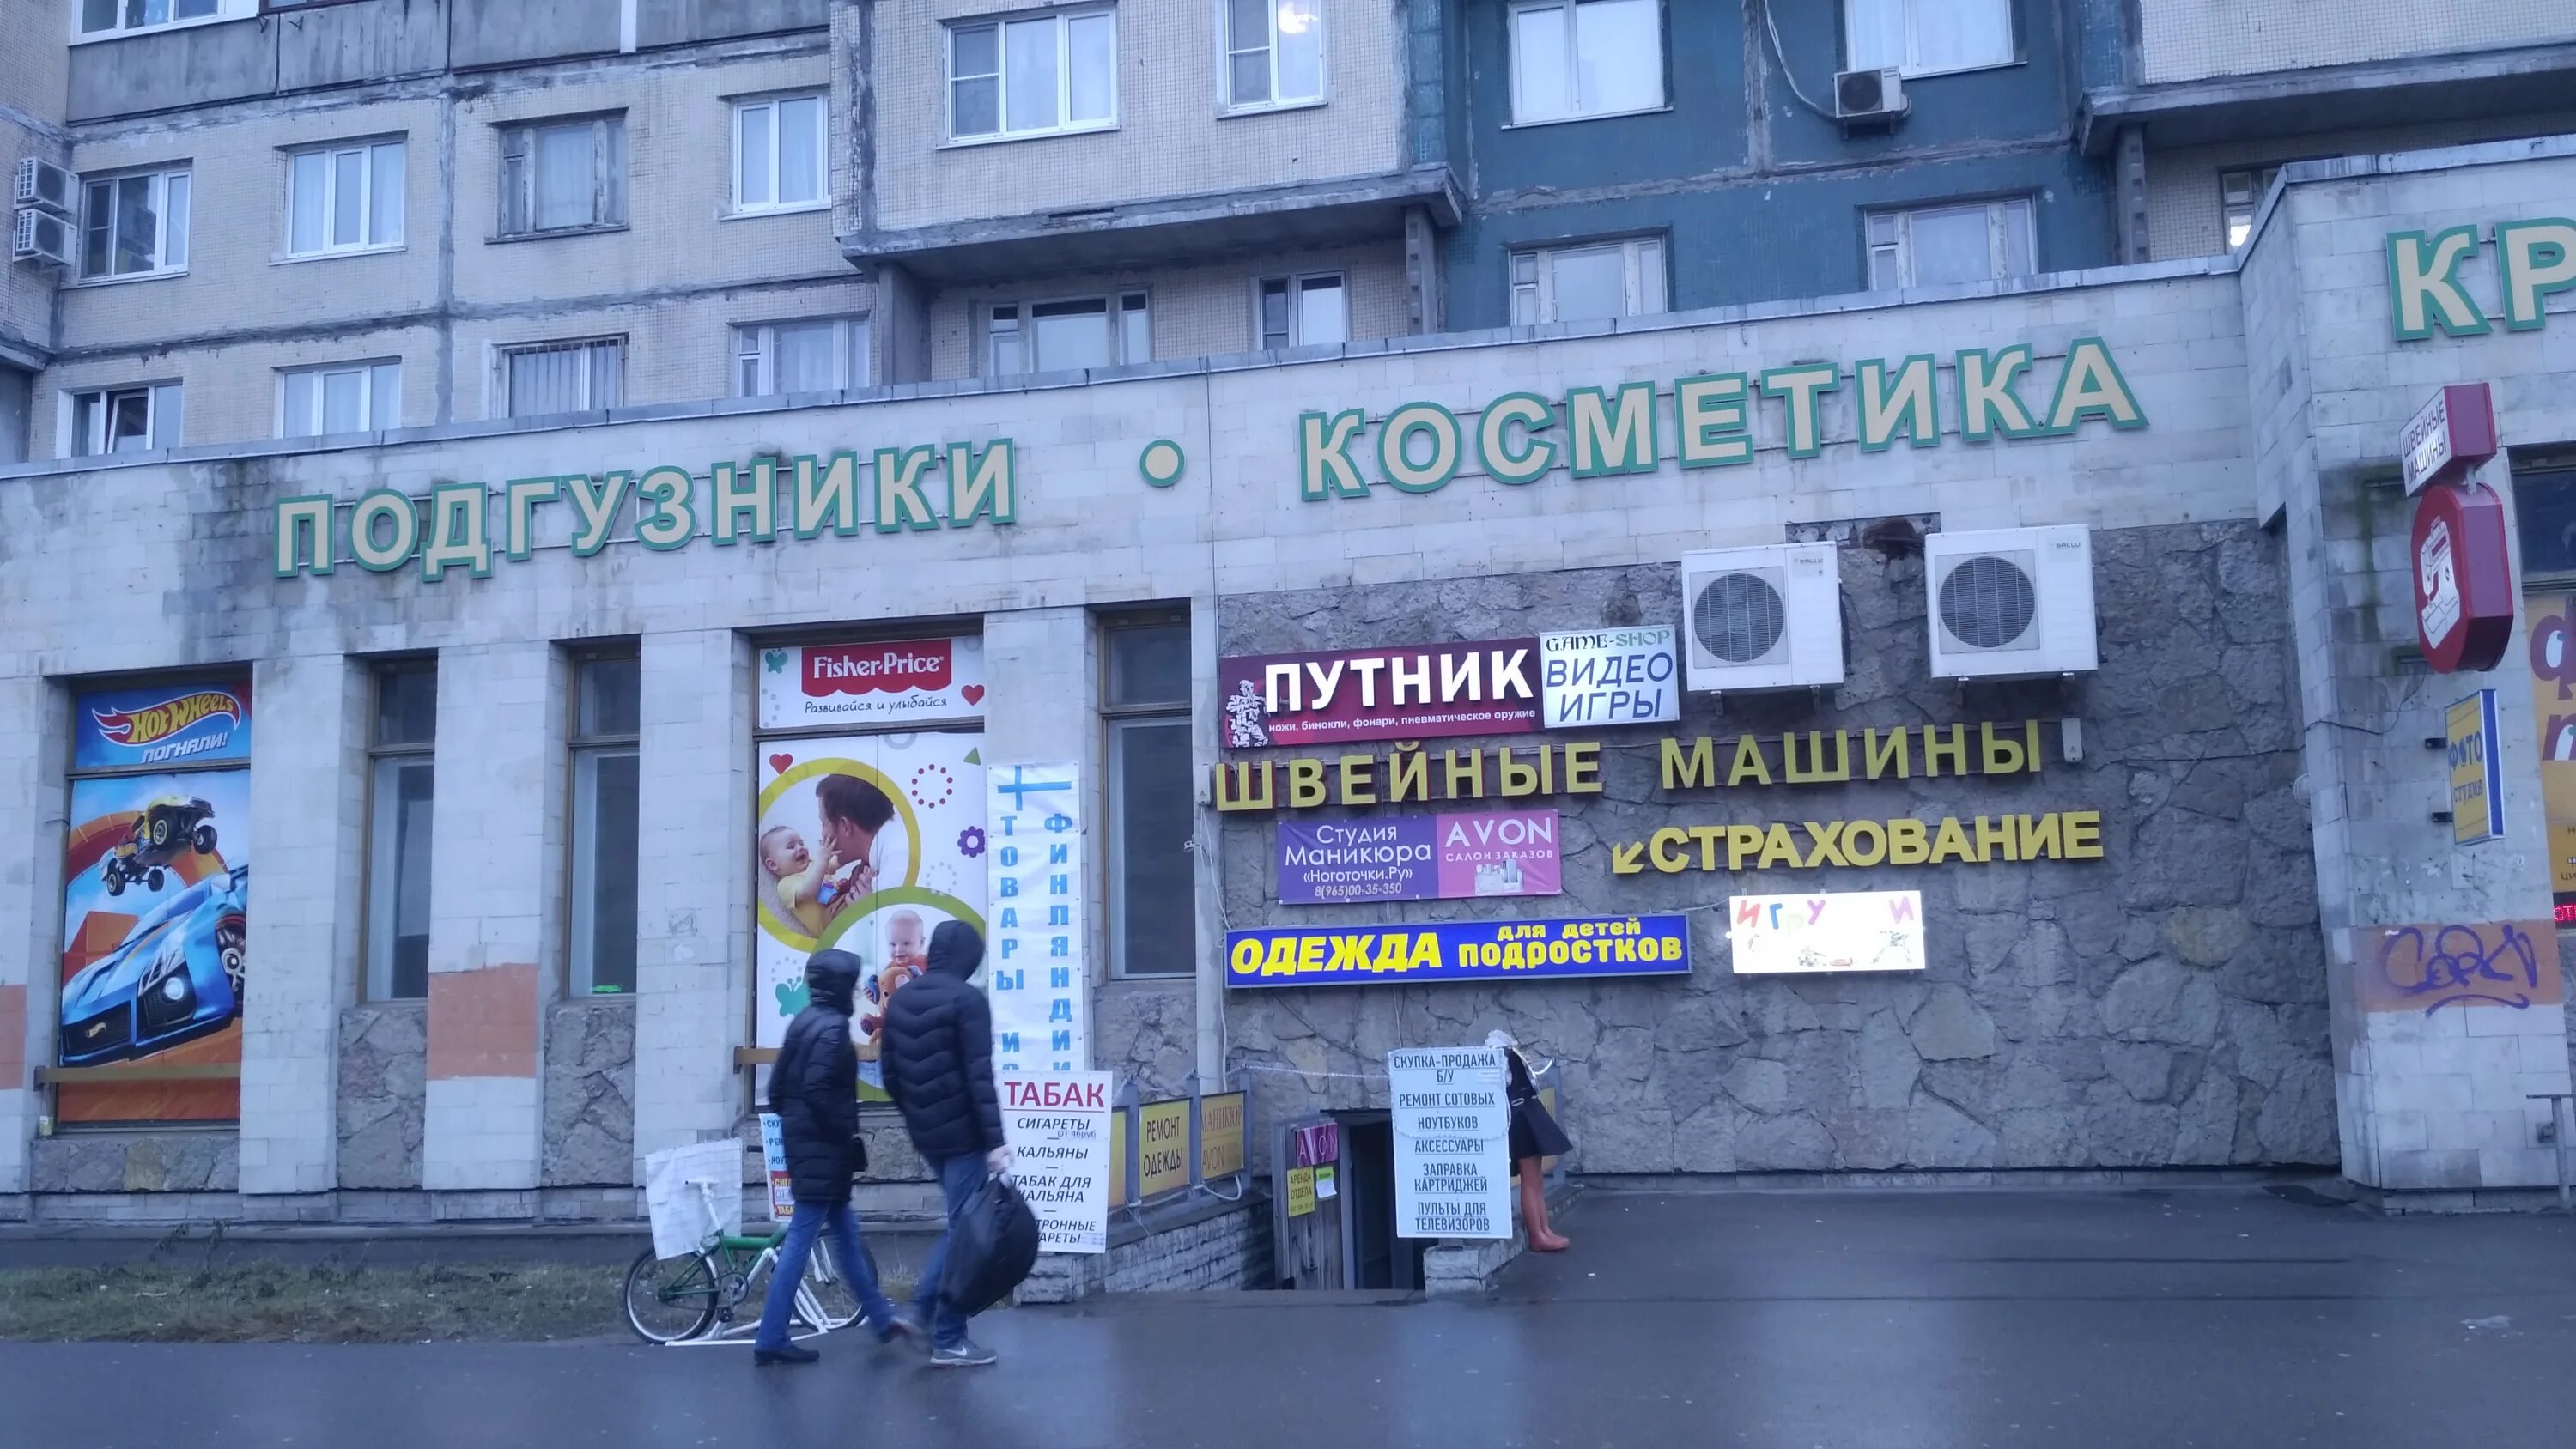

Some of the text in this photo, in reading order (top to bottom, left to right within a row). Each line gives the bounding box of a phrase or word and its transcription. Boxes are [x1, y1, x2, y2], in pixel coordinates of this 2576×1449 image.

[1298, 336, 2151, 502] КОСМЕТИКА
[2403, 400, 2445, 458] ШВЕЙНЫЕ
[2407, 431, 2447, 484] МАШИНЫ
[272, 437, 1016, 583] ПОДГУЗНИКИ
[1546, 629, 1670, 652] GAME-SHOP
[813, 652, 940, 679] Fisher-Price
[1546, 652, 1674, 688] ВИДЕО
[1264, 648, 1534, 713] ПУТНИК
[805, 694, 947, 714] Развивайся и улыбайся
[1559, 688, 1662, 723] ИГРЫ
[126, 709, 170, 743] HOT
[1268, 708, 1535, 732] ножи, бинокли, фонари, пневматическое оружие
[141, 731, 229, 764] ПОГНАЛИ!
[1215, 719, 2041, 811] ШВЕЙНЫЕ МАШИНЫ
[1316, 825, 1397, 846] Студия
[1444, 817, 1552, 848] AVON
[1649, 810, 2105, 874] СТРАХОВАНИЕ
[1285, 844, 1431, 867] Маникюра
[1445, 849, 1553, 862] САЛОН ЗАКАЗОВ
[1315, 882, 1402, 899] 8(965)00-35-350
[996, 816, 1024, 991] ТОВАРЫ
[1736, 895, 1915, 937] ИГРУИ
[1497, 916, 1641, 942] для детей
[1230, 932, 1443, 977] ОДЕЖДА
[1394, 1053, 1496, 1068] СКУПКА-ПРОДАЖА
[1436, 1070, 1454, 1083] Б/У
[1004, 1082, 1105, 1108] ТАБАК
[1399, 1092, 1495, 1106] РЕМОНТ СОТОВЫХ
[1017, 1117, 1091, 1130] СИГАРЕТЫ
[1146, 1116, 1181, 1143] РЕМОНТ
[1417, 1116, 1479, 1129] НОУТБУКОВ
[1017, 1146, 1088, 1159] КАЛЬЯНЫ
[1414, 1139, 1484, 1153] АКСЕССУАРЫ
[1144, 1148, 1184, 1179] ОДЕЖДЫ
[1423, 1163, 1478, 1176] ЗАПРАВКА
[1012, 1175, 1091, 1190] ТАБАК ДЛЯ
[1291, 1172, 1311, 1185] АРЕНДА
[1414, 1176, 1488, 1192] КАРТРИДЖЕЙ
[1291, 1186, 1312, 1201] ОТДЕЛА
[1417, 1203, 1486, 1217] ПУЛЬТЫ ДЛЯ
[1036, 1219, 1097, 1231] ТРОННЫЕ
[1415, 1217, 1490, 1232] ТЕЛЕВИЗОРОВ
[1037, 1232, 1082, 1244] АРЕТЫ
